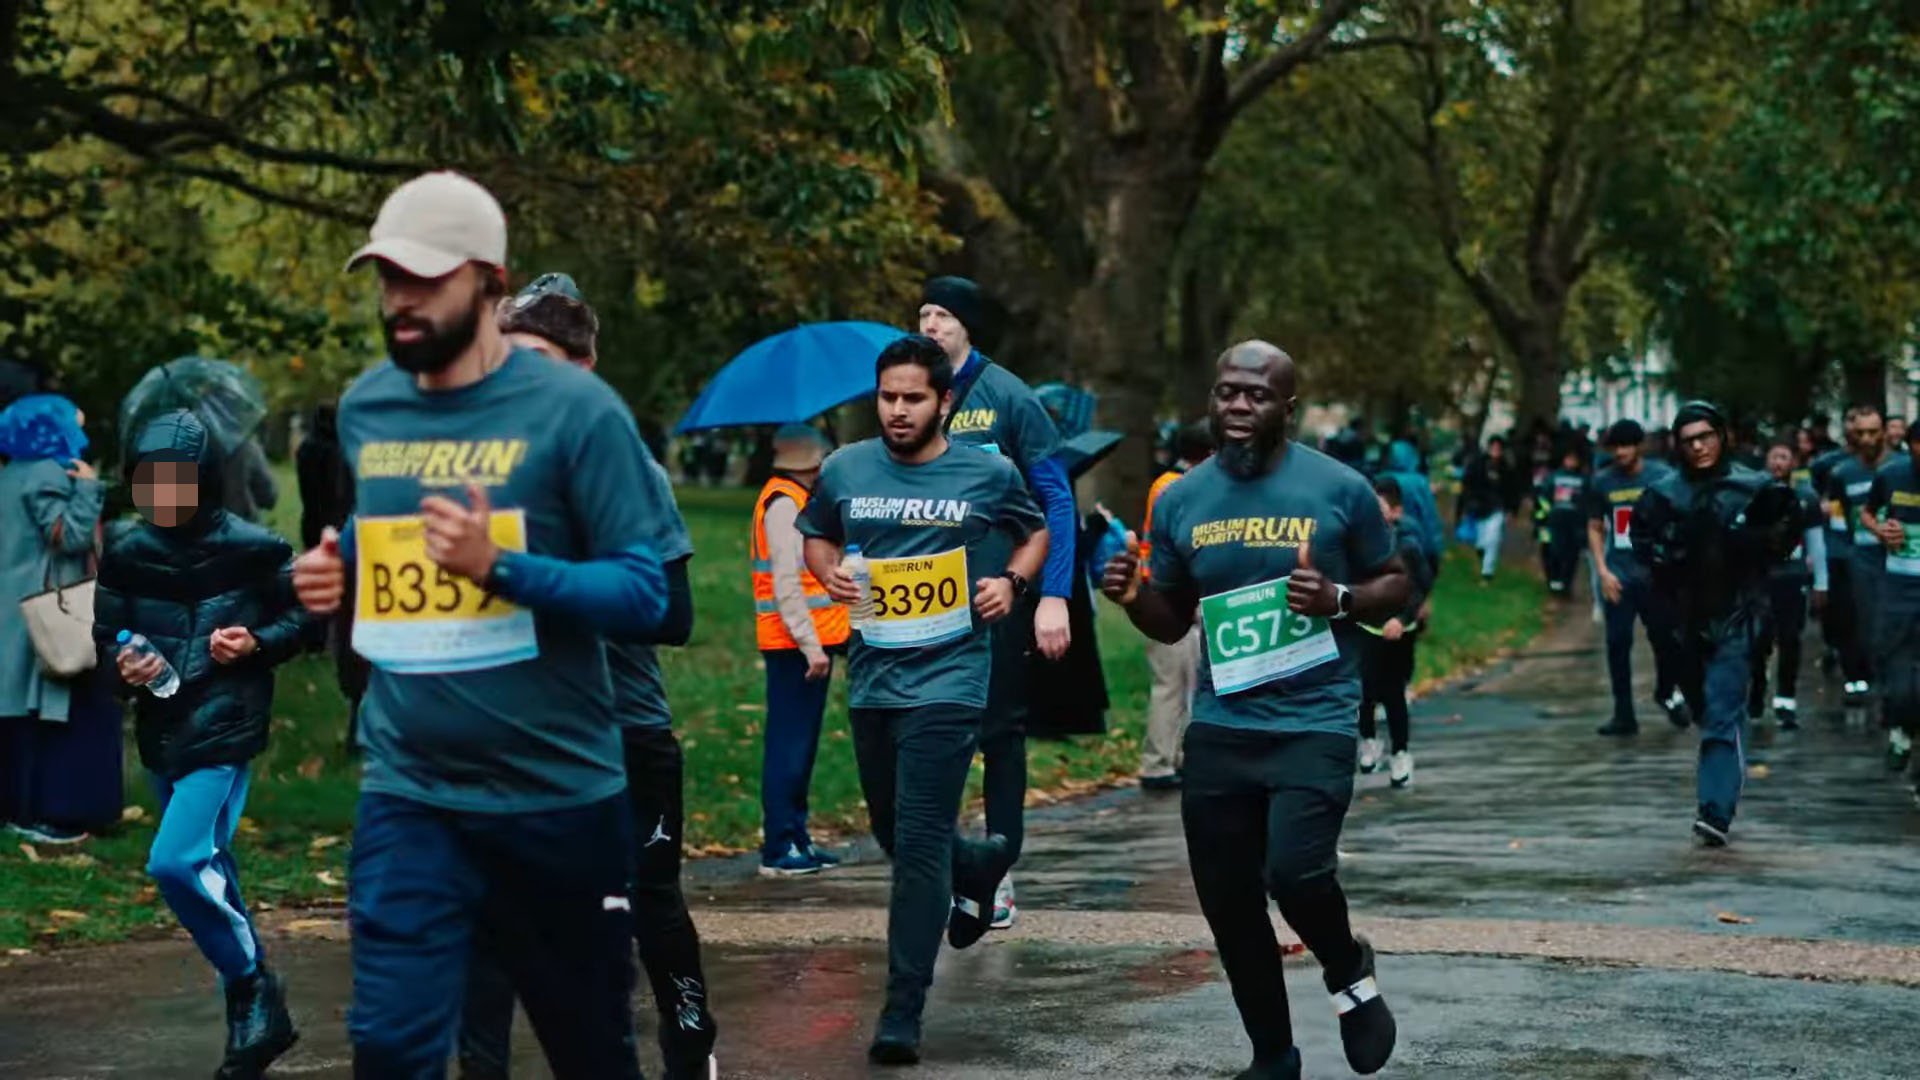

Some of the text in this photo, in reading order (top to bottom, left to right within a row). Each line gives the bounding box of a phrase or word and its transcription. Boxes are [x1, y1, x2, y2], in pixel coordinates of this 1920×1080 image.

[950, 408, 995, 429] RUN
[422, 440, 520, 477] RUN
[850, 508, 901, 519] CHARITY
[851, 497, 904, 509] MUSLIM
[903, 499, 967, 522] RUN
[1192, 518, 1244, 537] MUSLIM
[1244, 517, 1312, 541] RUN
[1191, 531, 1242, 549] CHARITY
[906, 560, 933, 572] RUN
[373, 562, 498, 614] B35
[870, 577, 957, 616] B390
[1216, 608, 1313, 657] C573
